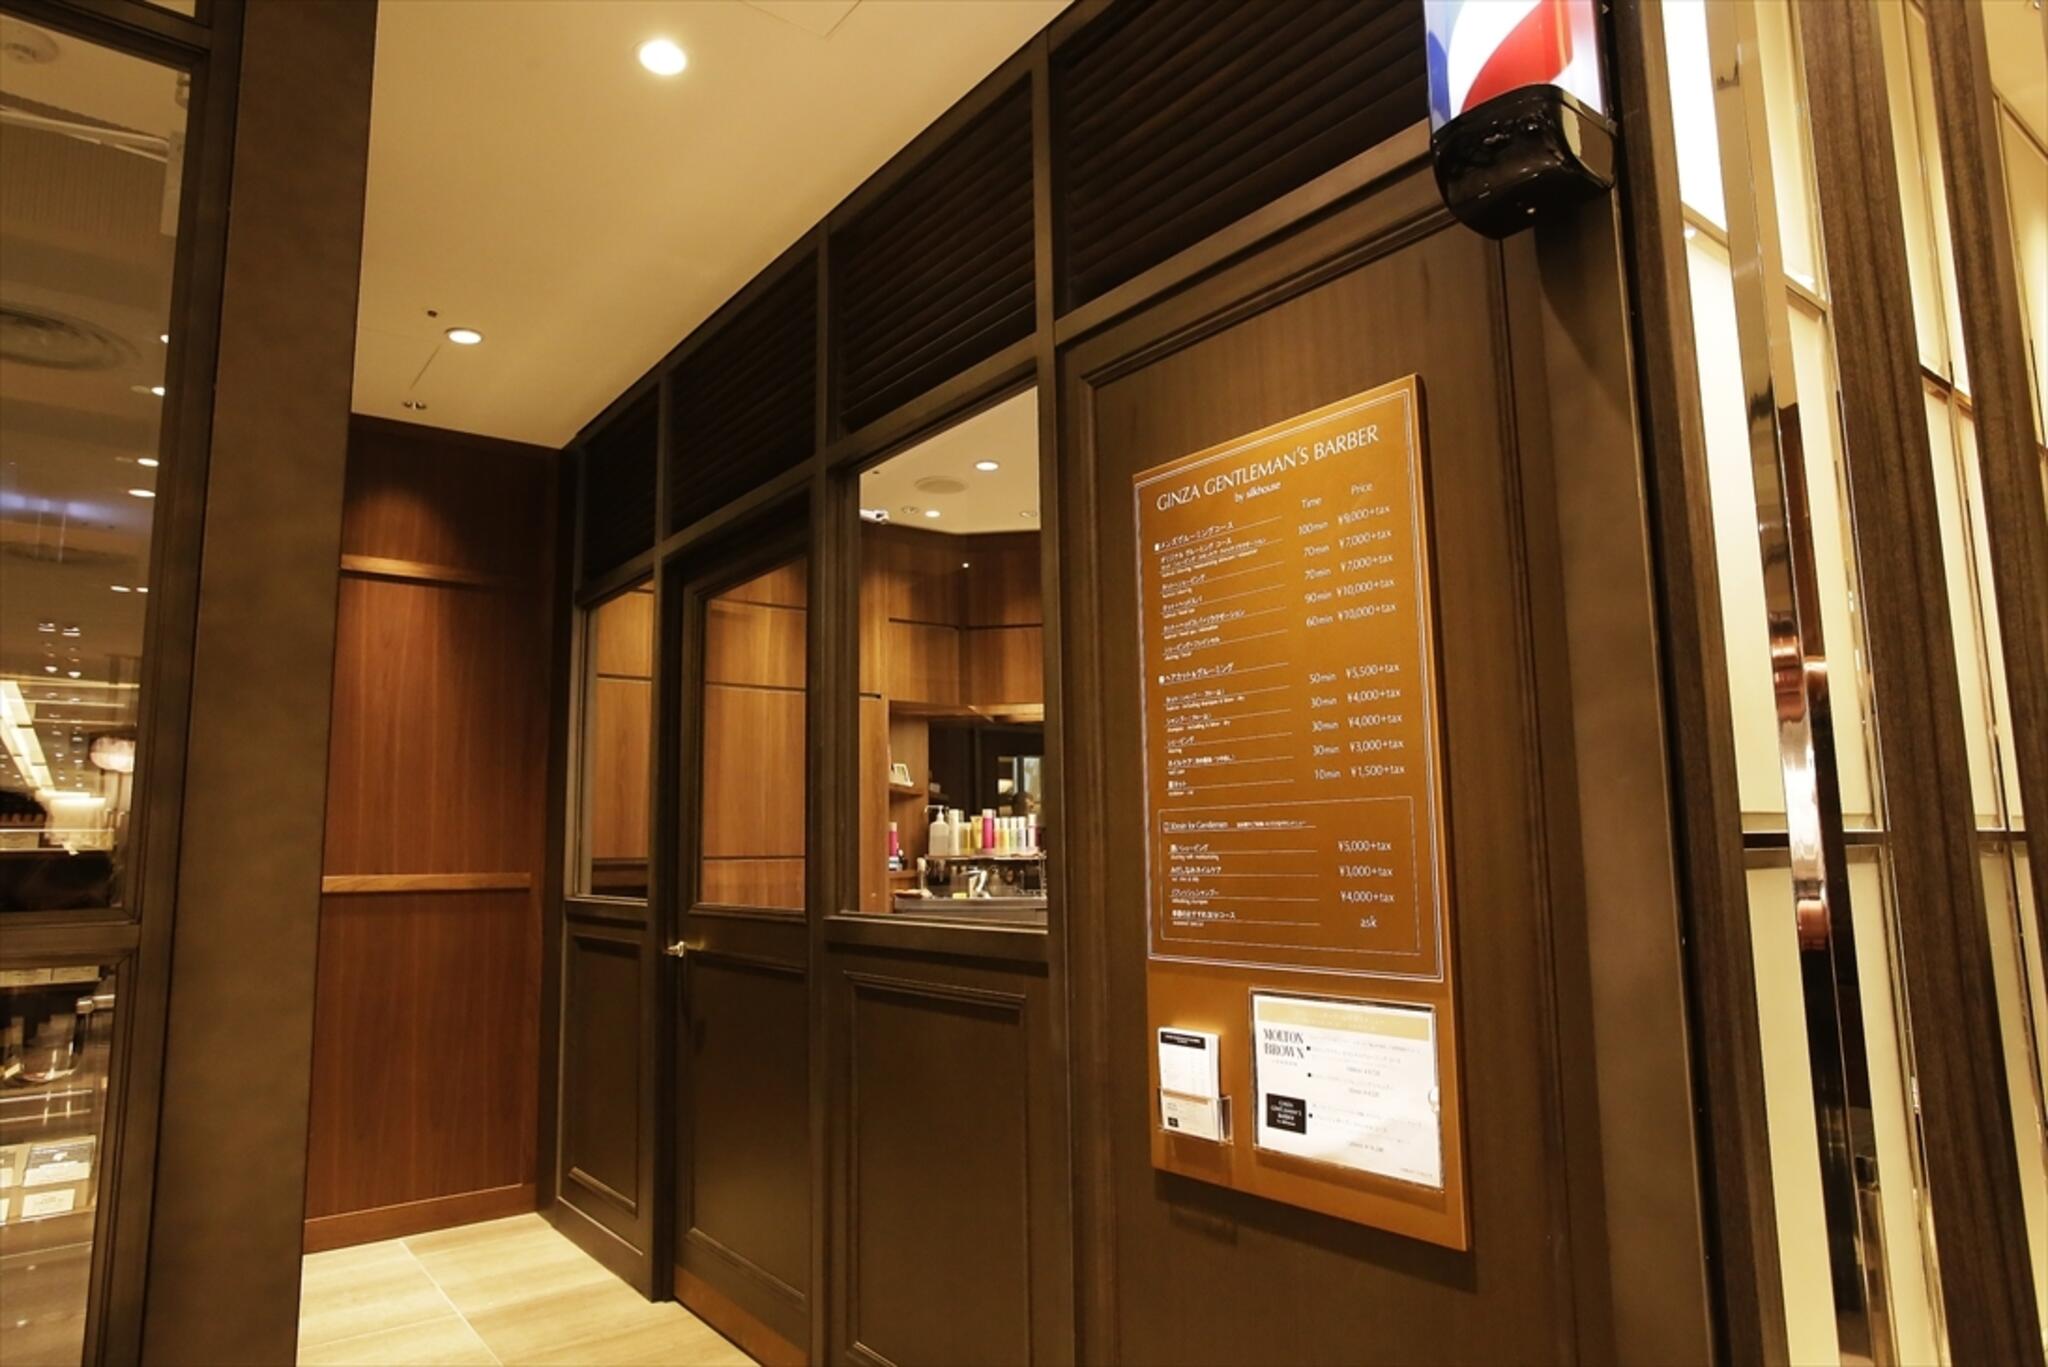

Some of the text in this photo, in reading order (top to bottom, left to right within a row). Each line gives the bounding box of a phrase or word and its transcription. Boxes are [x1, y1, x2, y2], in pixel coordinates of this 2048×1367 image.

[1156, 424, 1379, 511] GINZA GENTLEMAN'S BARBER
[1302, 483, 1373, 508] Time Price
[1345, 664, 1400, 679] ¥5,500+tax
[1347, 688, 1401, 703] ¥4,000+tax
[1348, 714, 1402, 728] ¥4,000+tax
[1350, 739, 1405, 753] ¥3,000+tax
[1314, 764, 1405, 780] 10min ¥1,500+tax
[1338, 840, 1392, 852] ¥5,000+tax
[1340, 890, 1395, 903] ¥4,000+tax
[1360, 915, 1377, 928] ask
[1263, 1028, 1304, 1044] MOLTON
[1264, 1042, 1304, 1059] BROWN
